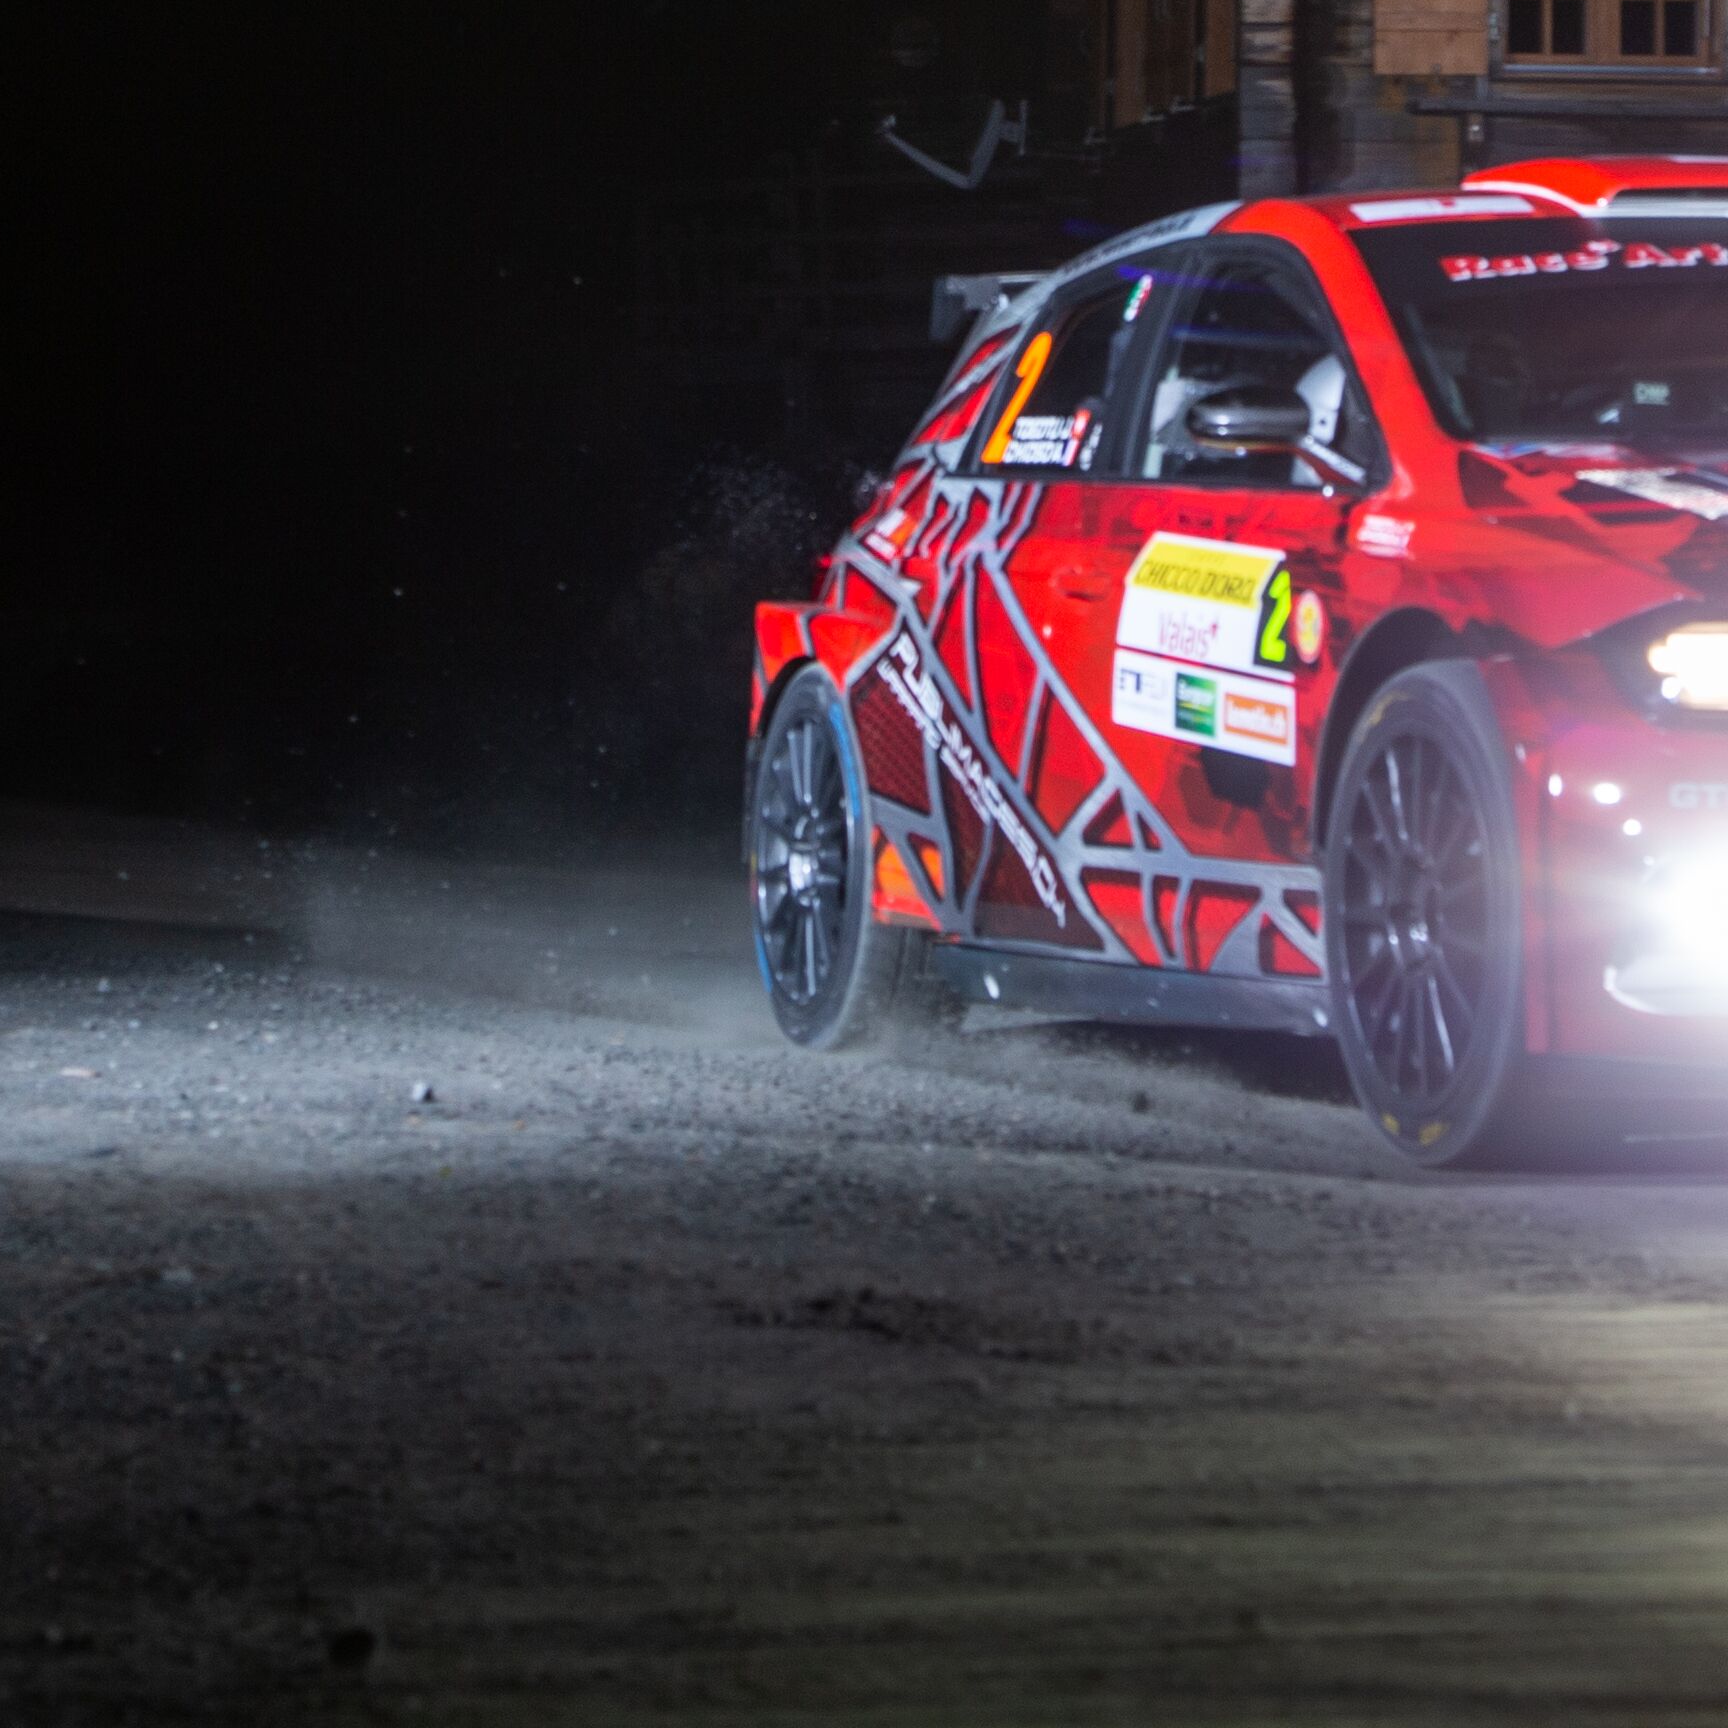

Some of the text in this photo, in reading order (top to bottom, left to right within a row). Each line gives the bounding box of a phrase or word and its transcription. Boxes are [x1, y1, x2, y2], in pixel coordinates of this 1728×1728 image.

[981, 331, 1052, 464] 2
[1133, 559, 1197, 594] CHICCO
[1158, 609, 1211, 659] Valais
[1260, 570, 1291, 663] 2
